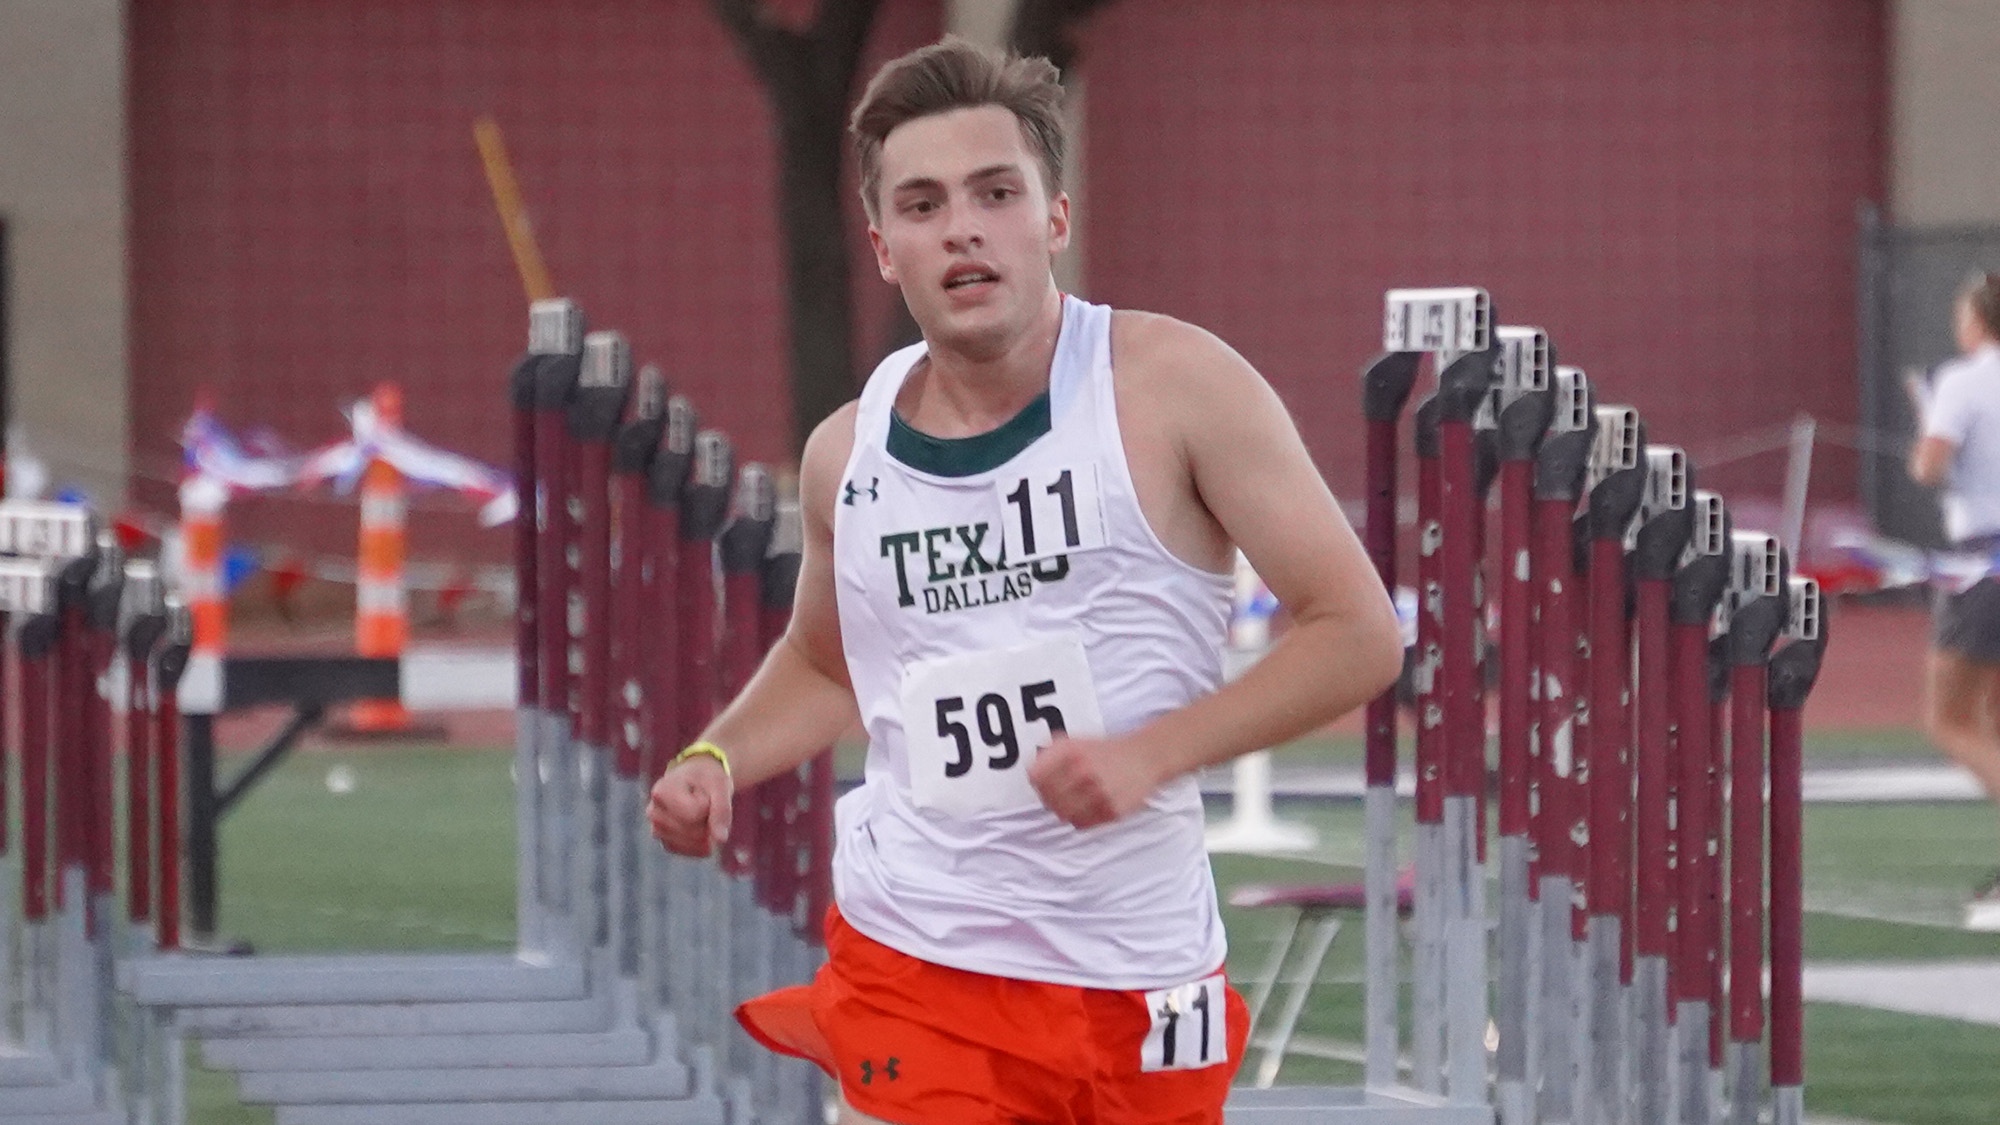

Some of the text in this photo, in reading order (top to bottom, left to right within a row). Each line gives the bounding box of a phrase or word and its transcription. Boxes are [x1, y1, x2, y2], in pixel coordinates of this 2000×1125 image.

[1006, 469, 1080, 556] 11
[880, 521, 1069, 609] TEX
[923, 571, 1032, 615] DALLAS
[935, 679, 1070, 777] 595
[1157, 984, 1209, 1067] 11
